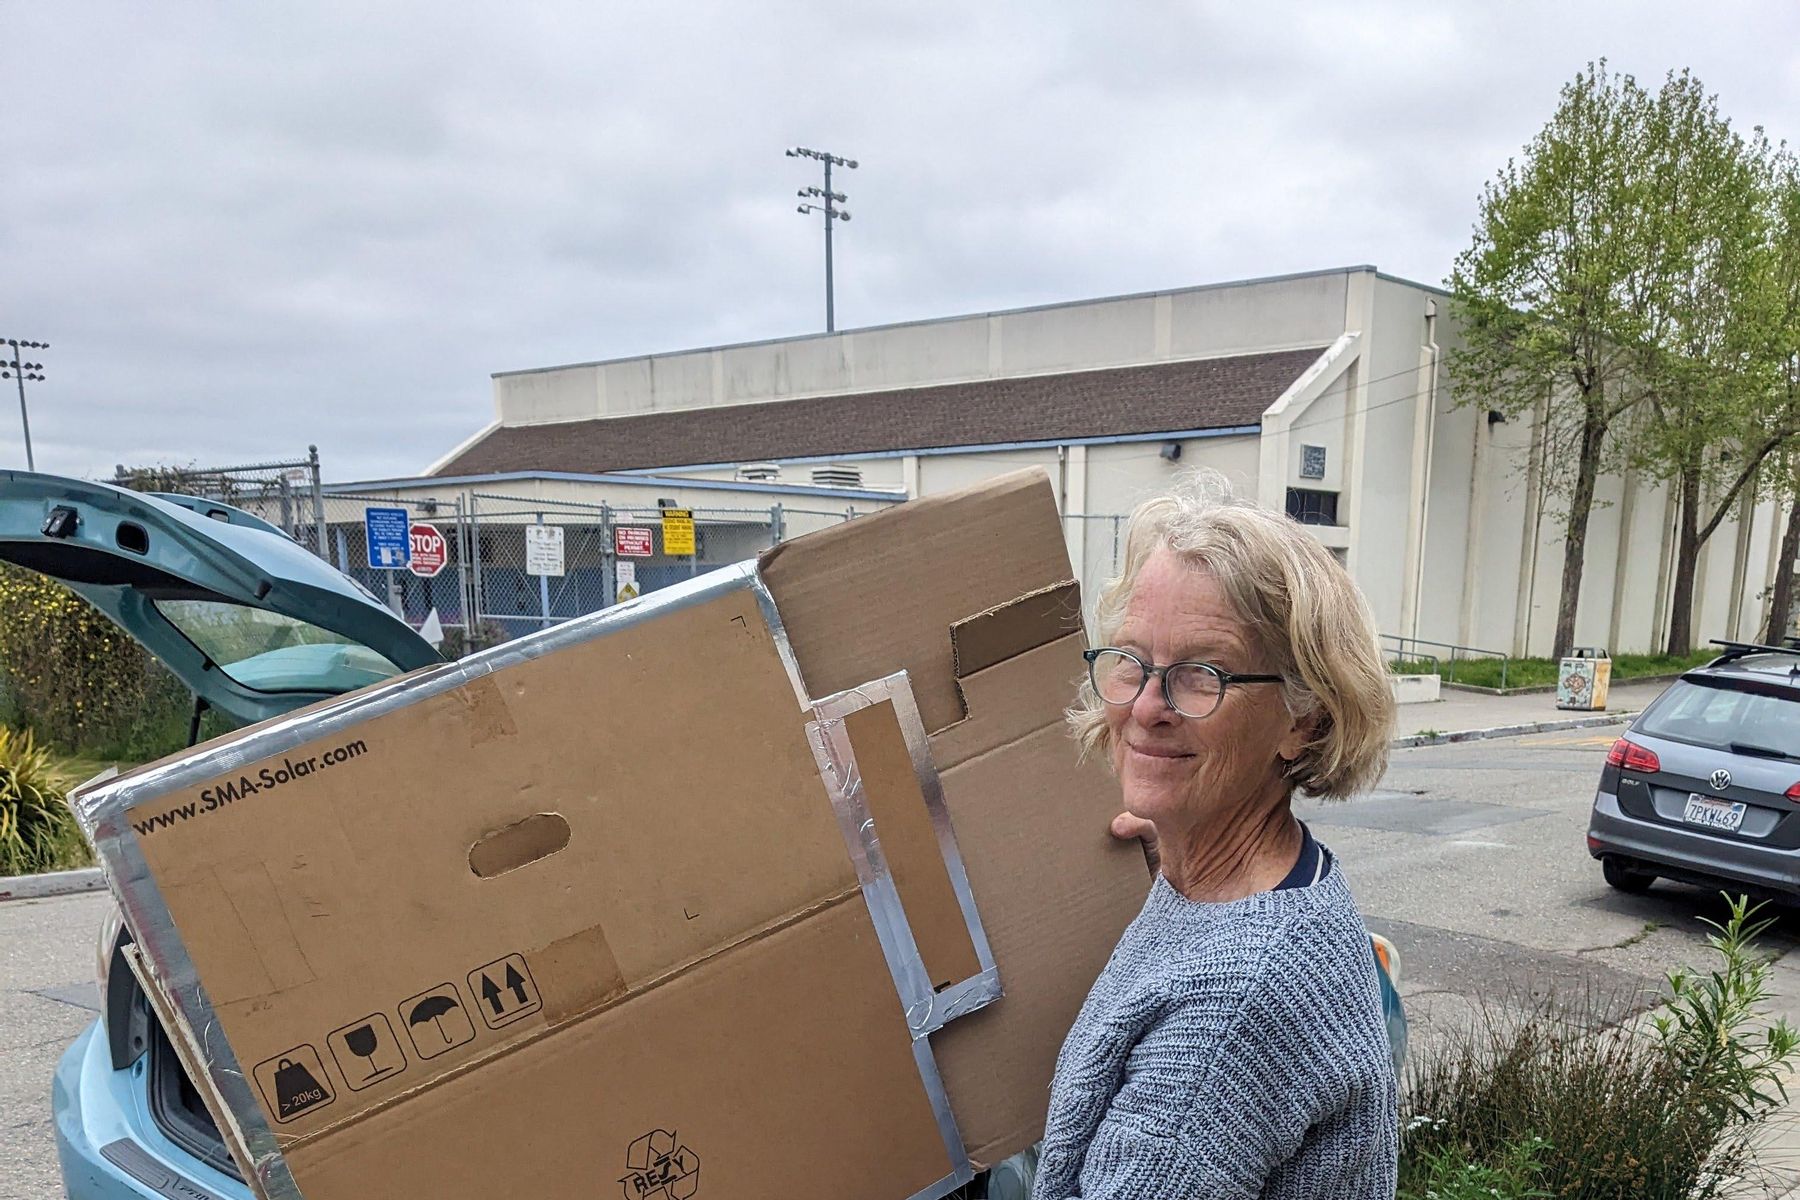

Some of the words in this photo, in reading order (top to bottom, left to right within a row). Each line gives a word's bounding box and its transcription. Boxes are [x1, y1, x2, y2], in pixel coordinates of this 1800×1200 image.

[409, 534, 441, 553] STOP
[133, 737, 368, 837] www.SMA-Solar.com
[1691, 804, 1739, 826] 7PKW469
[292, 1085, 323, 1110] 20kg
[632, 1154, 685, 1195] RESY
